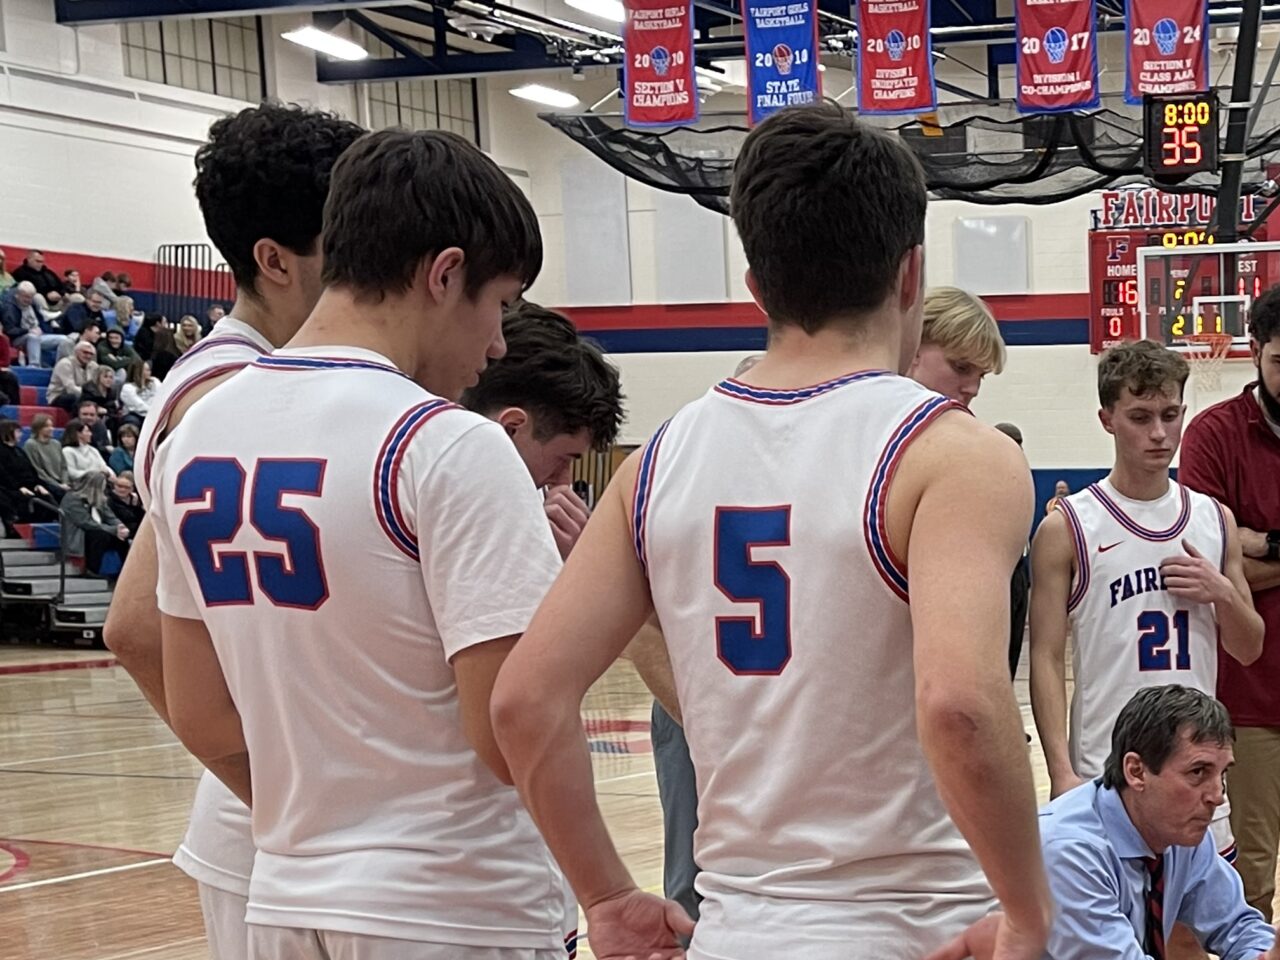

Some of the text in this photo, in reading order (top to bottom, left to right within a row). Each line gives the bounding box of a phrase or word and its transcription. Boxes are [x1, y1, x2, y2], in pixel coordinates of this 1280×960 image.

[756, 15, 805, 28] BASKETBALL
[1021, 31, 1090, 54] 20 17
[1133, 25, 1200, 46] 20 24
[867, 38, 884, 53] 20
[634, 54, 650, 68] 20
[755, 53, 773, 67] 20
[1140, 69, 1195, 83] CLASS AAA
[634, 78, 685, 94] SECTION V
[766, 79, 800, 94] STATE
[1021, 80, 1092, 96] CO-CHAMPIONS
[633, 91, 689, 107] CHAMPIONS
[757, 90, 814, 108] FINAL FOUR
[1165, 102, 1210, 126] 8:00
[1162, 126, 1202, 165] 35
[1101, 190, 1256, 226] FAIRPOT
[1107, 264, 1137, 276] HOME
[1237, 260, 1258, 273] EST
[1118, 280, 1139, 305] 16
[1109, 317, 1122, 337] 0
[174, 456, 331, 612] 25
[713, 504, 792, 676] 5
[1109, 566, 1168, 609] FAIR
[1137, 609, 1191, 672] 21
